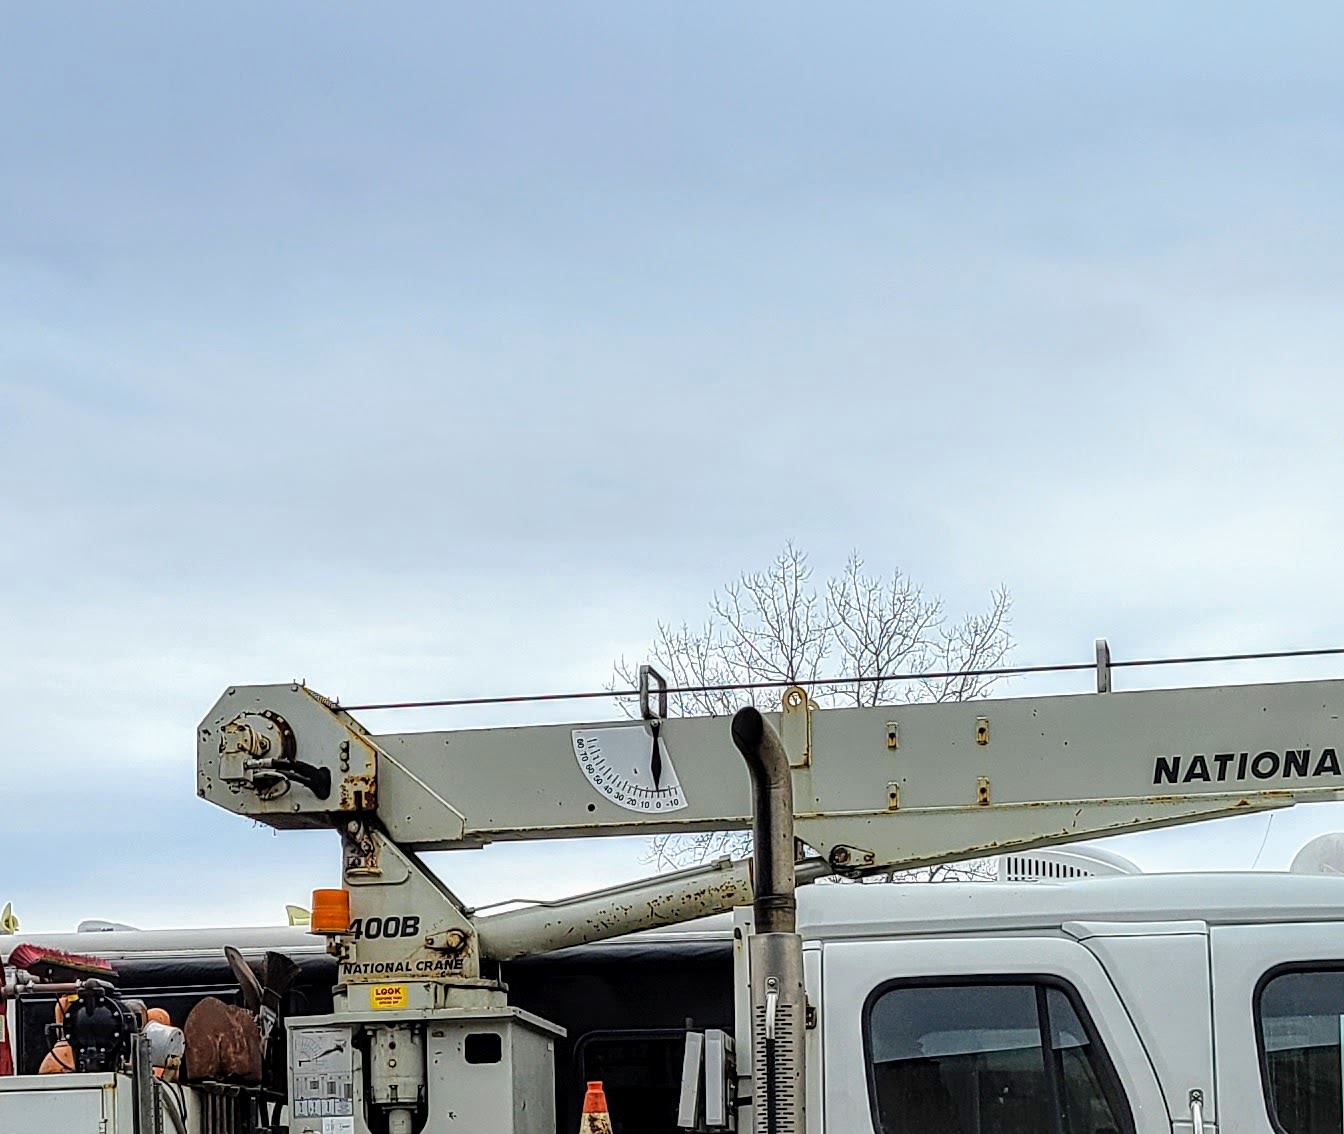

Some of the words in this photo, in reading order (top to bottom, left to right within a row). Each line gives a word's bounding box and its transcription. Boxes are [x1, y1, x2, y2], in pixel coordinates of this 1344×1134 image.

[579, 751, 589, 762] 70
[586, 763, 595, 774] 60
[593, 775, 603, 785] 50
[603, 785, 613, 794] 40
[614, 792, 624, 801] 30
[626, 797, 636, 806] 20
[666, 799, 679, 807] -10
[348, 916, 420, 939] 400B
[343, 962, 412, 974] NATIONAL
[416, 959, 464, 971] CRANE
[375, 987, 402, 996] LOOK
